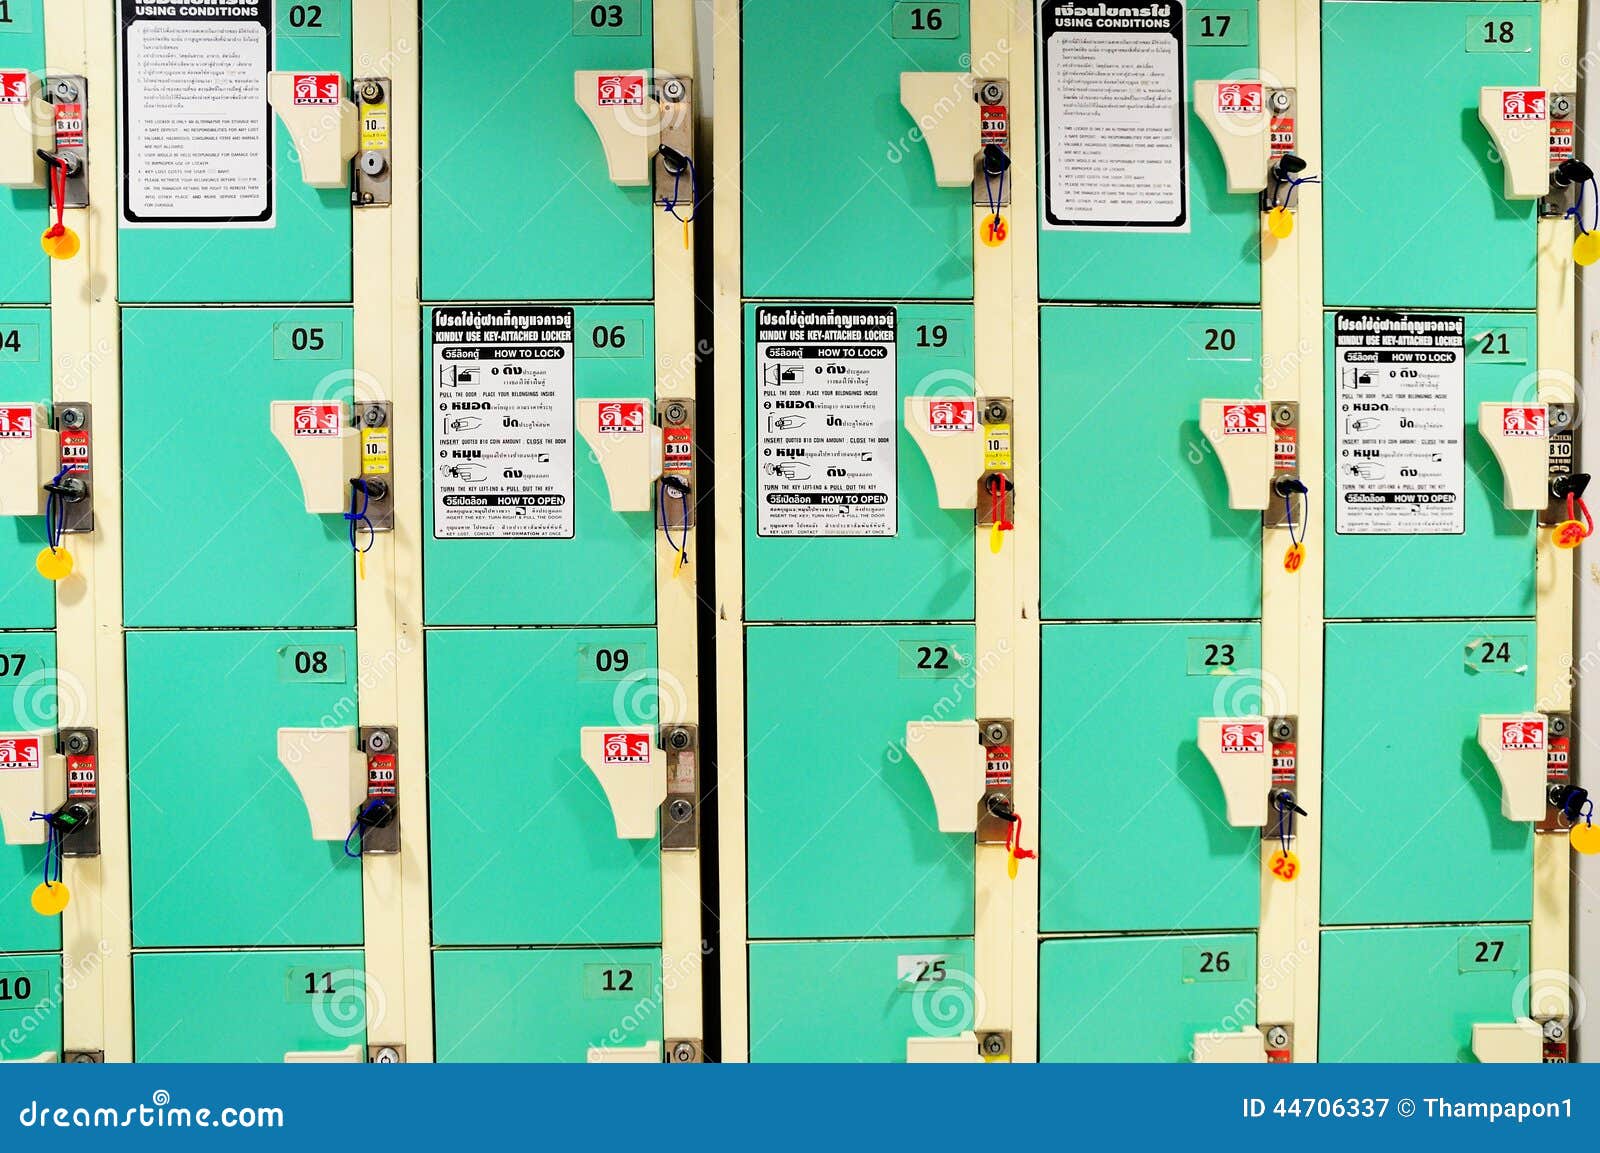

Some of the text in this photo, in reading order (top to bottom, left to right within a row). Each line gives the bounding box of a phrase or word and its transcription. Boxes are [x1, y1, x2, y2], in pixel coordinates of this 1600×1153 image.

[135, 6, 258, 16] USING CONDITIONS
[289, 5, 322, 28] 02
[590, 4, 623, 28] 03
[911, 8, 942, 31] 16
[1055, 18, 1170, 28] USING CONDITIONS
[1200, 15, 1231, 37] 17
[1484, 21, 1514, 44] 18
[366, 120, 376, 130] 10
[988, 223, 1006, 242] 16
[291, 328, 324, 351] 05
[436, 331, 571, 341] KINDLY USE KEY-ATTACHED LOCKER
[592, 325, 625, 349] 06
[760, 330, 894, 340] KINDLY USE KEY-ATTACHED LOCKER
[915, 325, 948, 348] 19
[1204, 329, 1236, 352] 20
[1481, 332, 1510, 356] 21
[494, 350, 560, 358] HOW TO LOCK
[818, 348, 884, 356] HOW TO LOCK
[1392, 354, 1452, 362] HOW TO LOCK
[366, 444, 378, 454] 10
[988, 440, 1000, 450] 10
[498, 497, 564, 505] HOW TO OPEN
[821, 496, 887, 504] HOW TO OPEN
[1394, 494, 1456, 502] HOW TO OPEN
[1284, 552, 1300, 571] 20
[294, 651, 328, 674] 08
[595, 649, 628, 672] 09
[916, 646, 949, 670] 22
[1204, 644, 1235, 667] 23
[1481, 641, 1511, 664] 24
[1273, 858, 1296, 879] 23
[1199, 952, 1230, 973] 26
[1475, 941, 1504, 963] 27
[602, 970, 634, 991] 12
[916, 960, 946, 982] 25
[0, 977, 31, 1000] 10
[304, 972, 336, 994] 11
